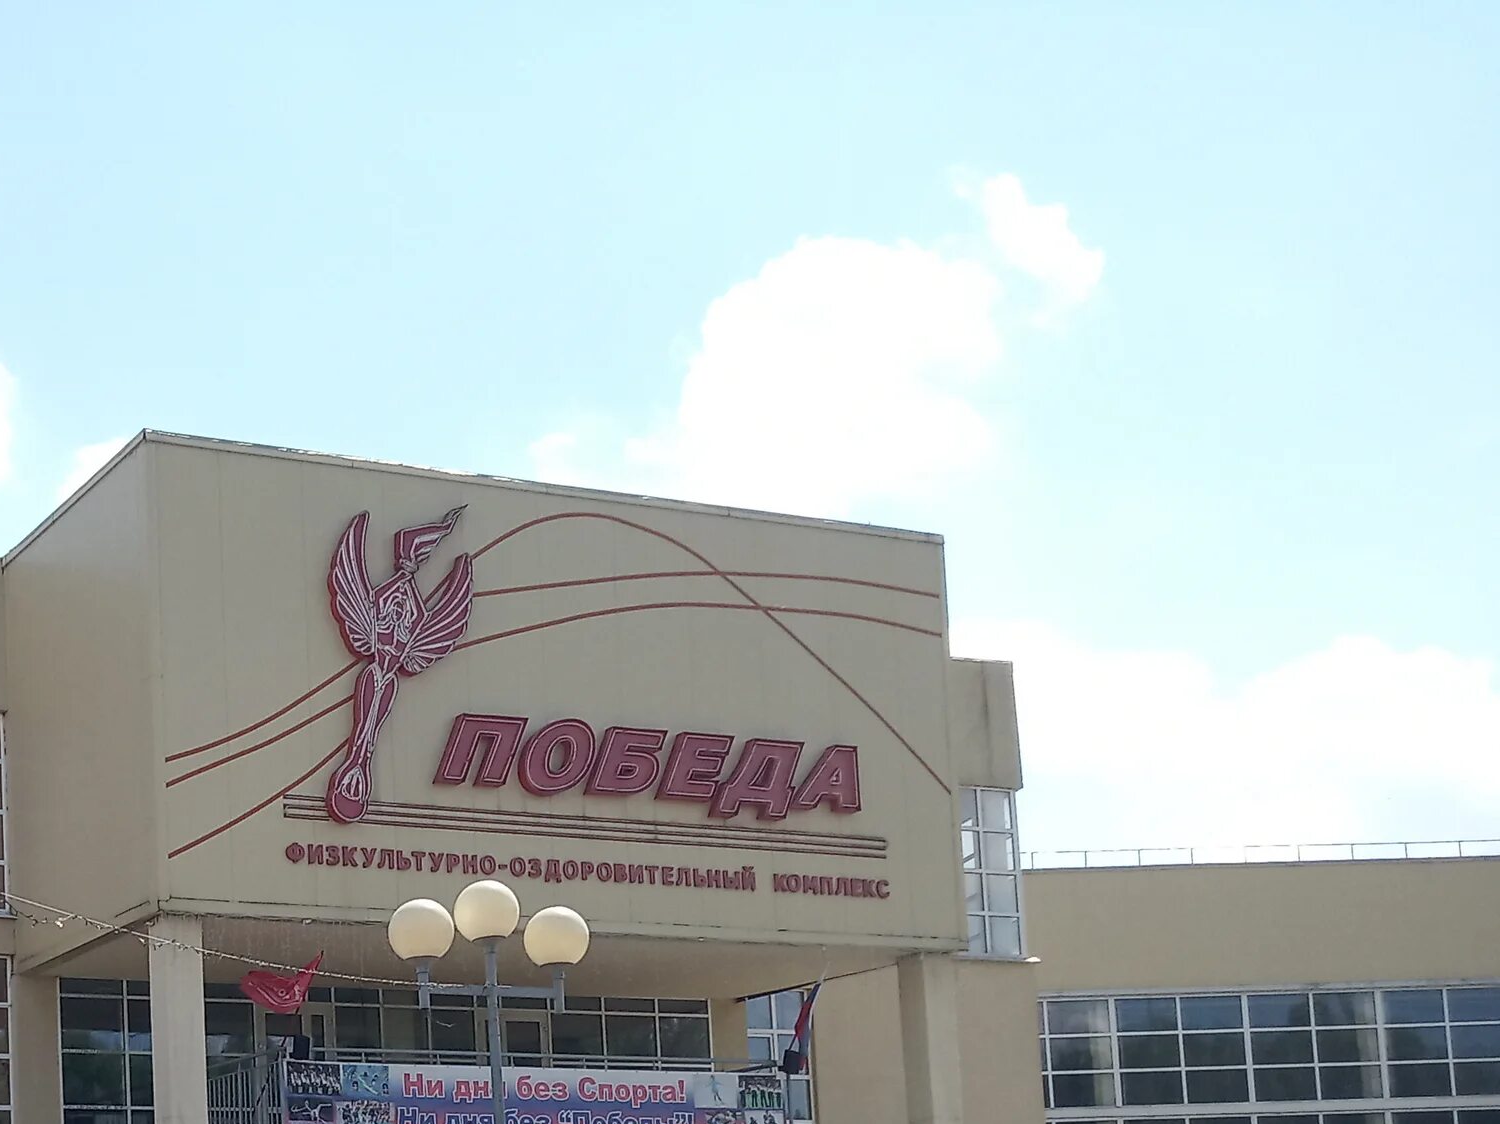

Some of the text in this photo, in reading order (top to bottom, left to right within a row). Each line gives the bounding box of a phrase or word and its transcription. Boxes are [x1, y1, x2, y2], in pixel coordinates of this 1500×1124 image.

[433, 713, 862, 820] ПОБЕДА
[285, 842, 891, 899] ФИЗКУЛЬТУРНО-ОЗДОРОВИТЕЛЬНЫЙ КОМПЛЕКС
[402, 1072, 687, 1108] Ни дн без Спорта!
